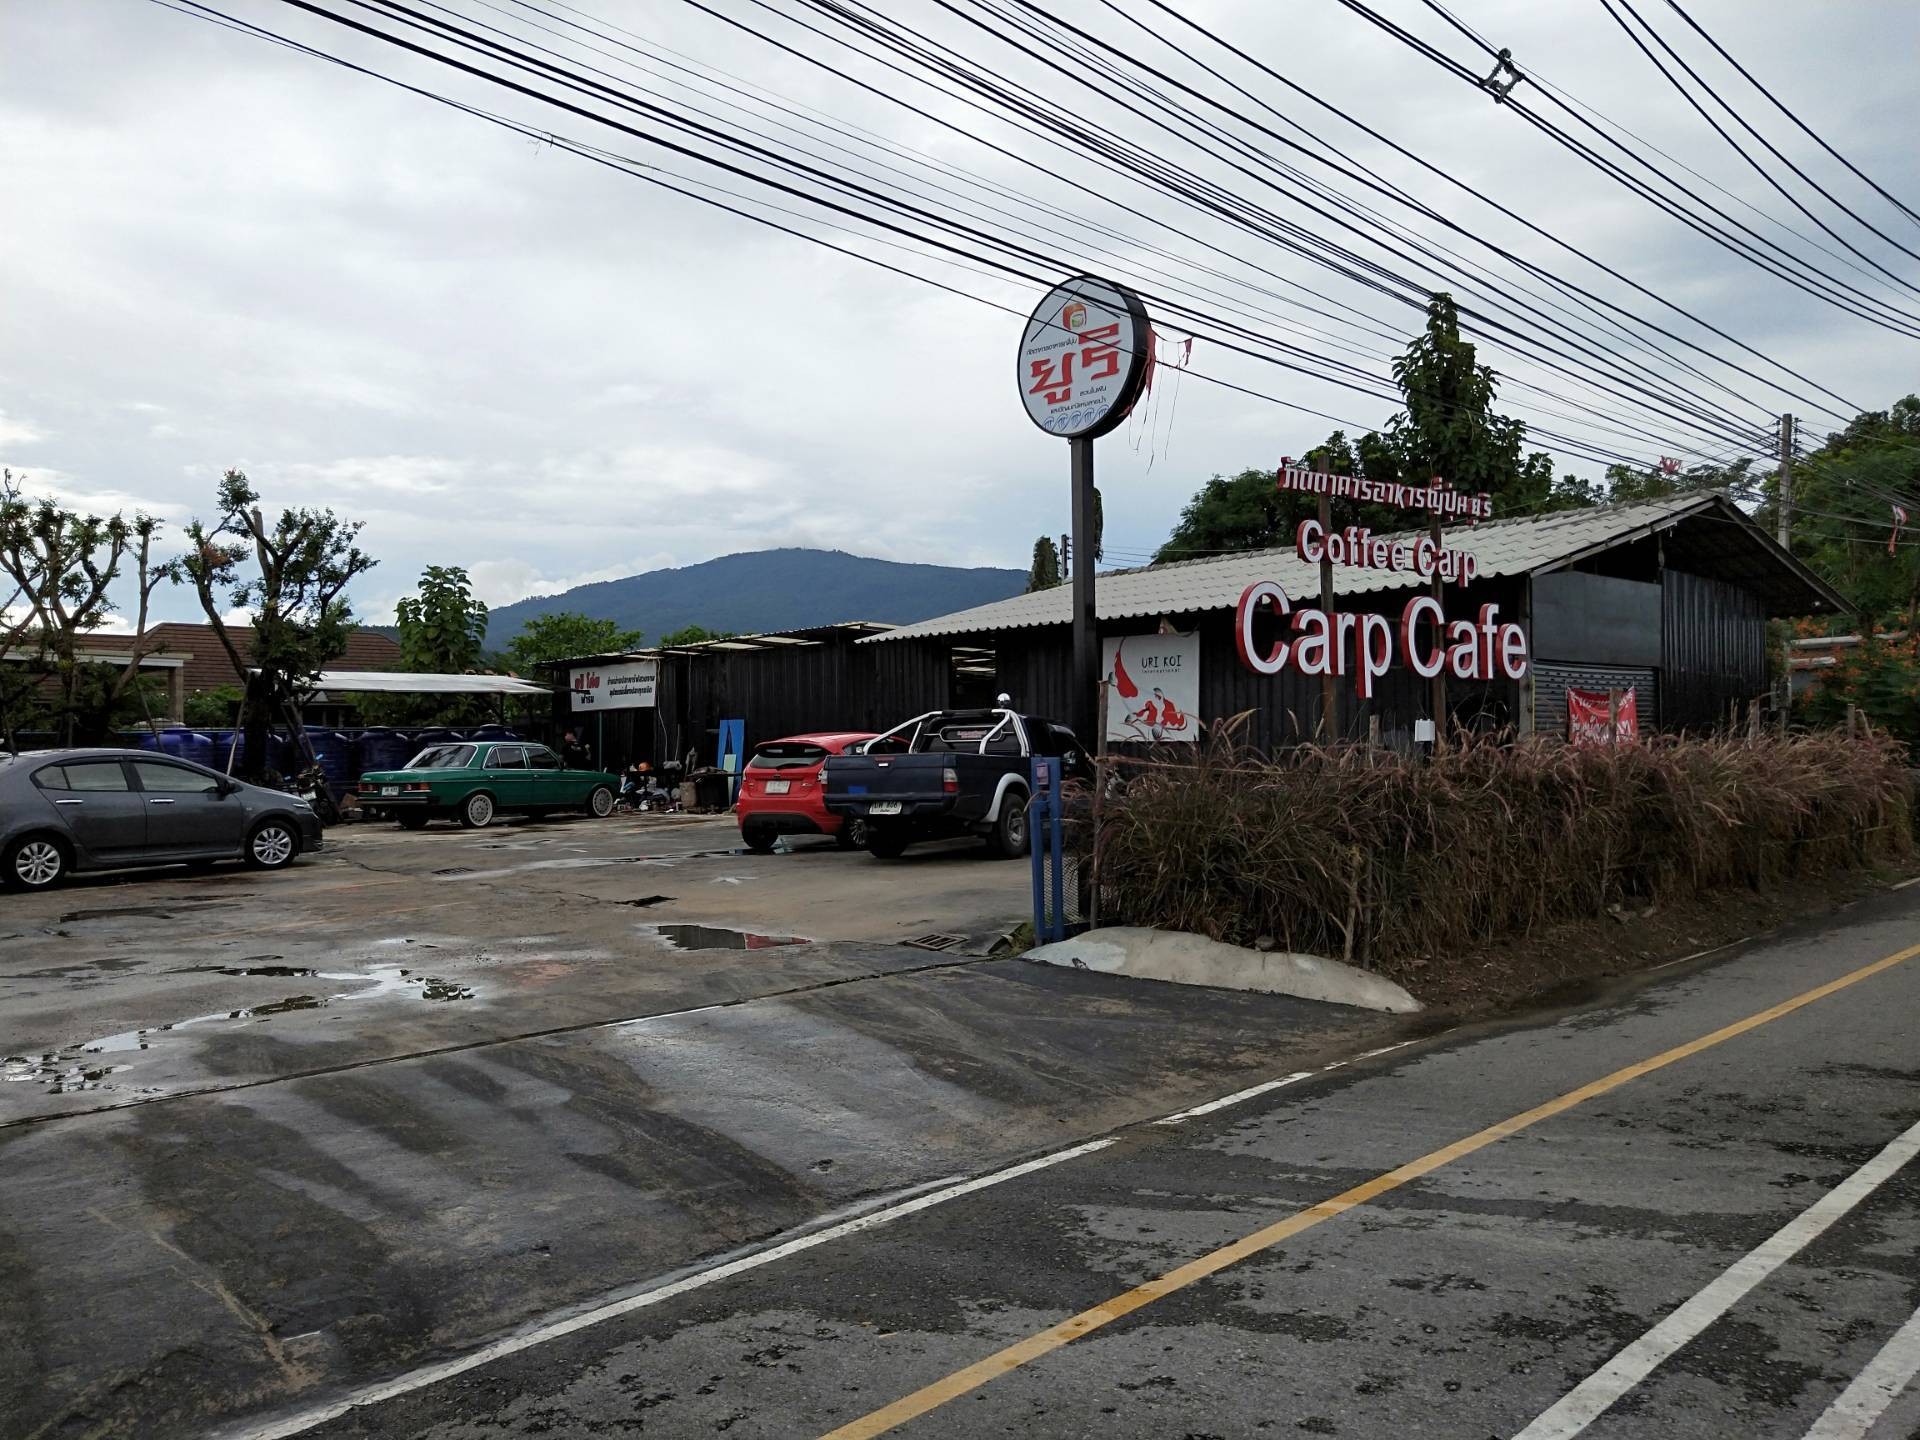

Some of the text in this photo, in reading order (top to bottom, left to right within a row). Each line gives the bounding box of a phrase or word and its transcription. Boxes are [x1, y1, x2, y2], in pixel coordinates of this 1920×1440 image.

[1297, 519, 1478, 587] Coffee Carp
[1141, 655, 1182, 668] URI KOI
[1236, 581, 1527, 698] Carp Cafe
